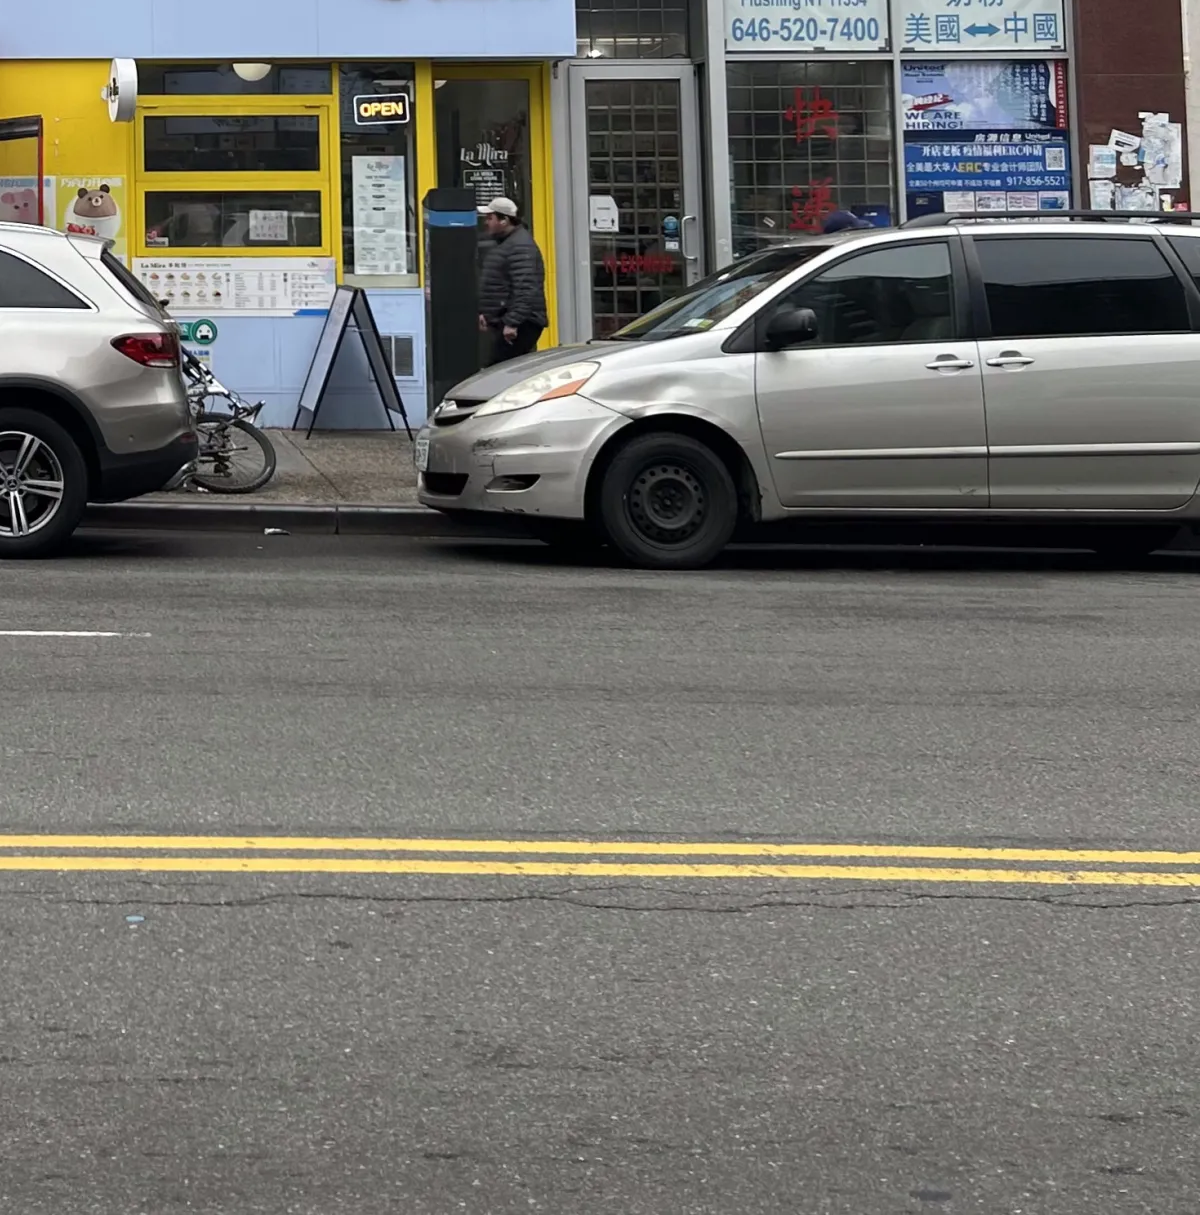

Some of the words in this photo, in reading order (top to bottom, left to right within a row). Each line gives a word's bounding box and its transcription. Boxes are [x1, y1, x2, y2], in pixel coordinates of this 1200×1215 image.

[731, 17, 879, 42] 646-520-7400
[904, 12, 961, 44] 美國
[1003, 12, 1058, 44] 中國
[359, 101, 404, 117] OPEN
[905, 121, 963, 129] HIRING!
[460, 147, 482, 166] La
[476, 143, 508, 166] Mira
[1006, 176, 1066, 186] 917-856-5521
